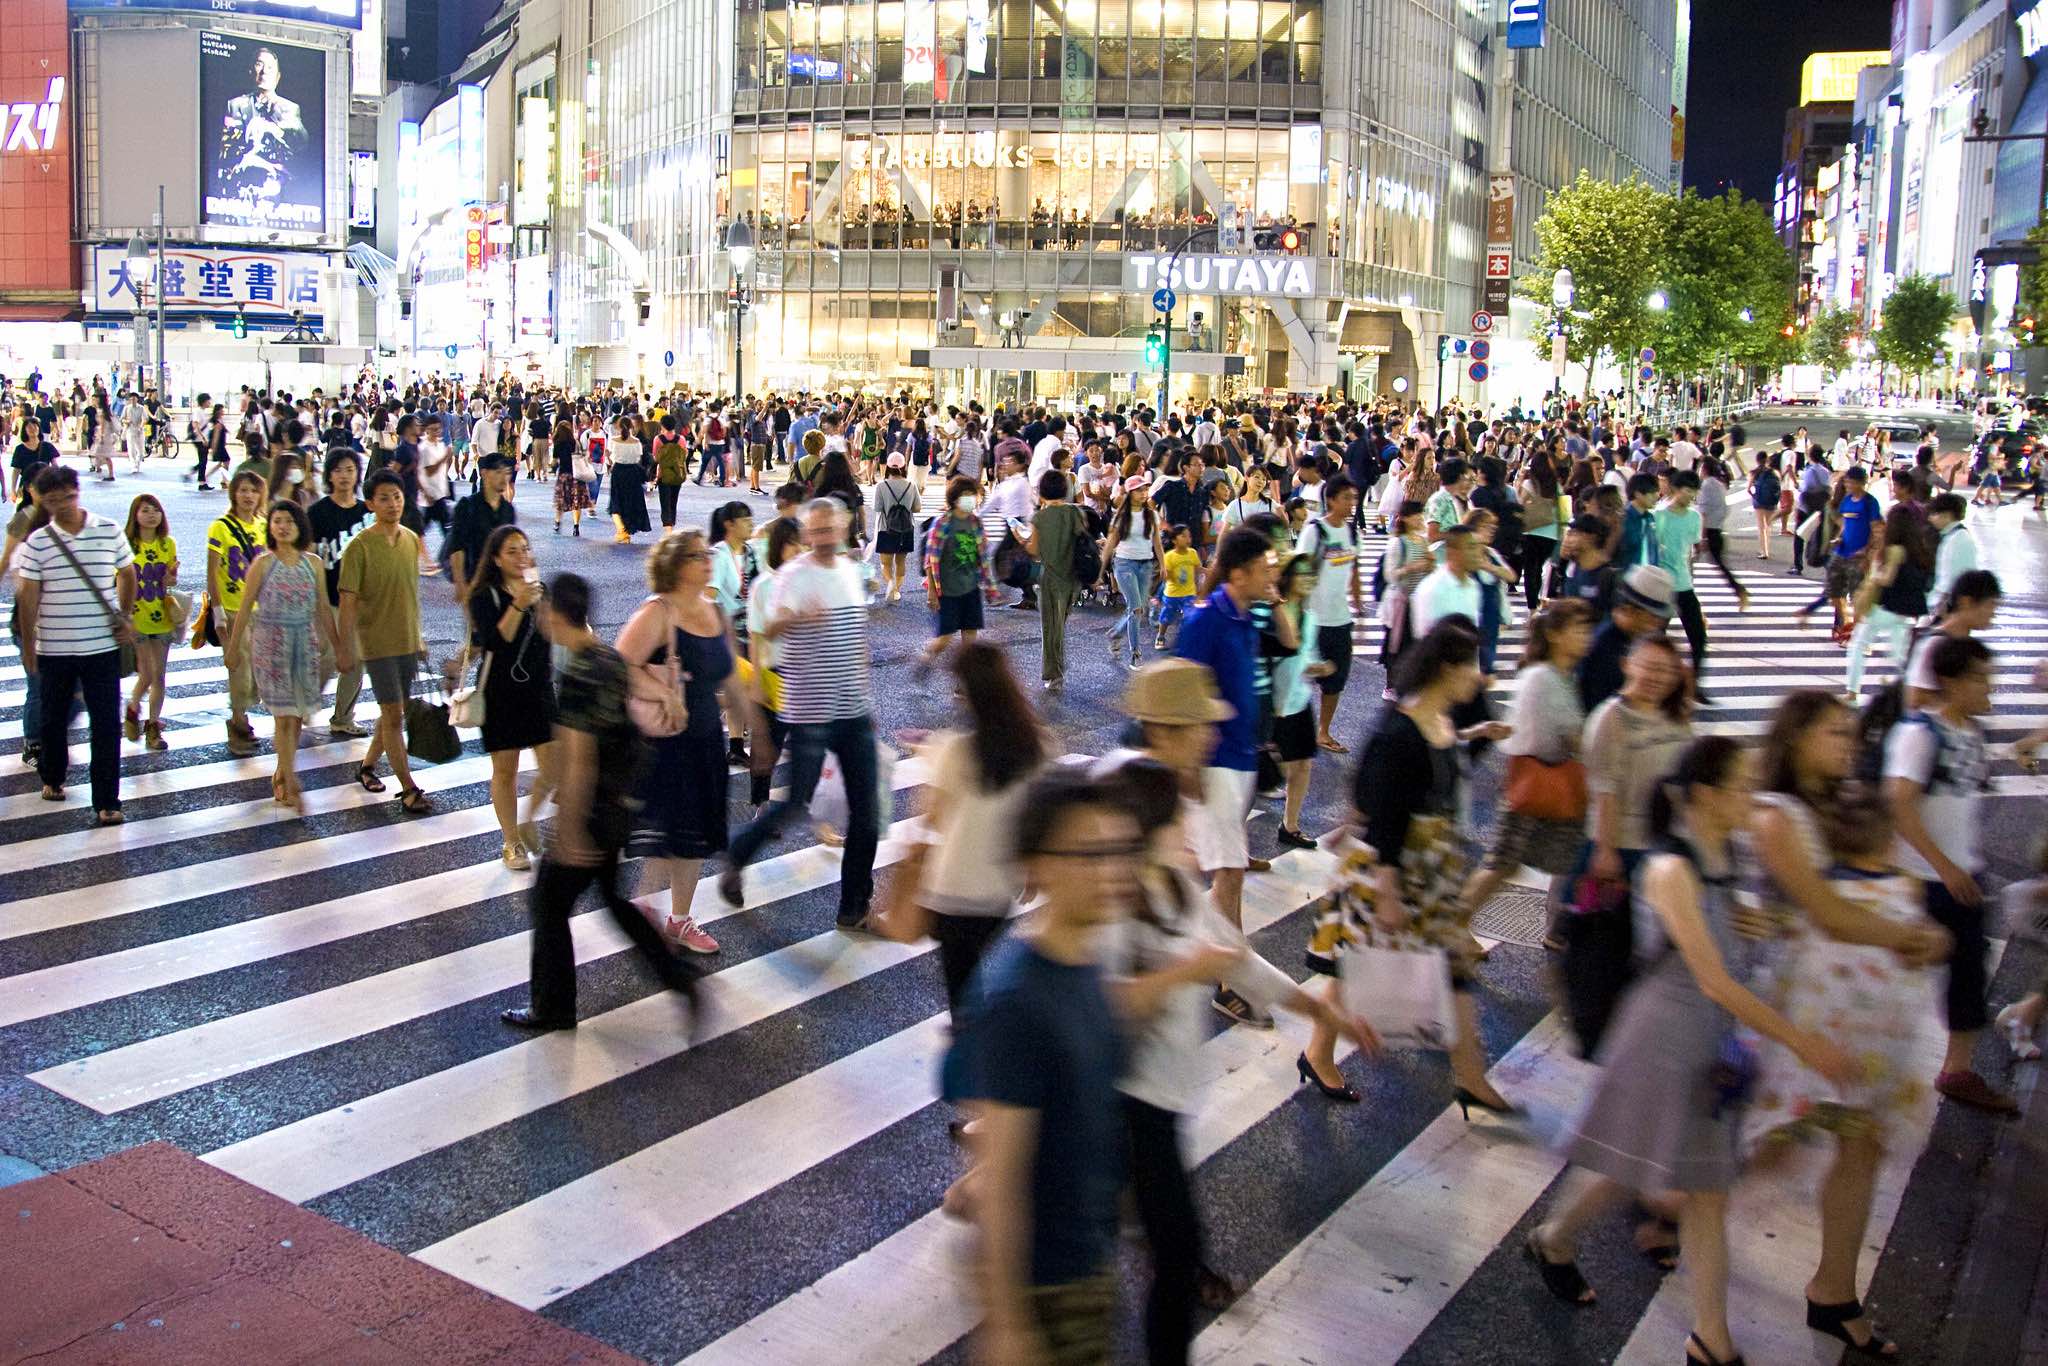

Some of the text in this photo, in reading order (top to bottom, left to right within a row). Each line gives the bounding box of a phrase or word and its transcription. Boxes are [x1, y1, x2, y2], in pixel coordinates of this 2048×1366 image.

[211, 0, 237, 10] DHC
[850, 145, 1171, 169] STARBUCKS COFFEE
[1130, 256, 1312, 293] TSUTAYA
[1490, 257, 1507, 273] 本
[108, 261, 319, 303] 大盛堂書店
